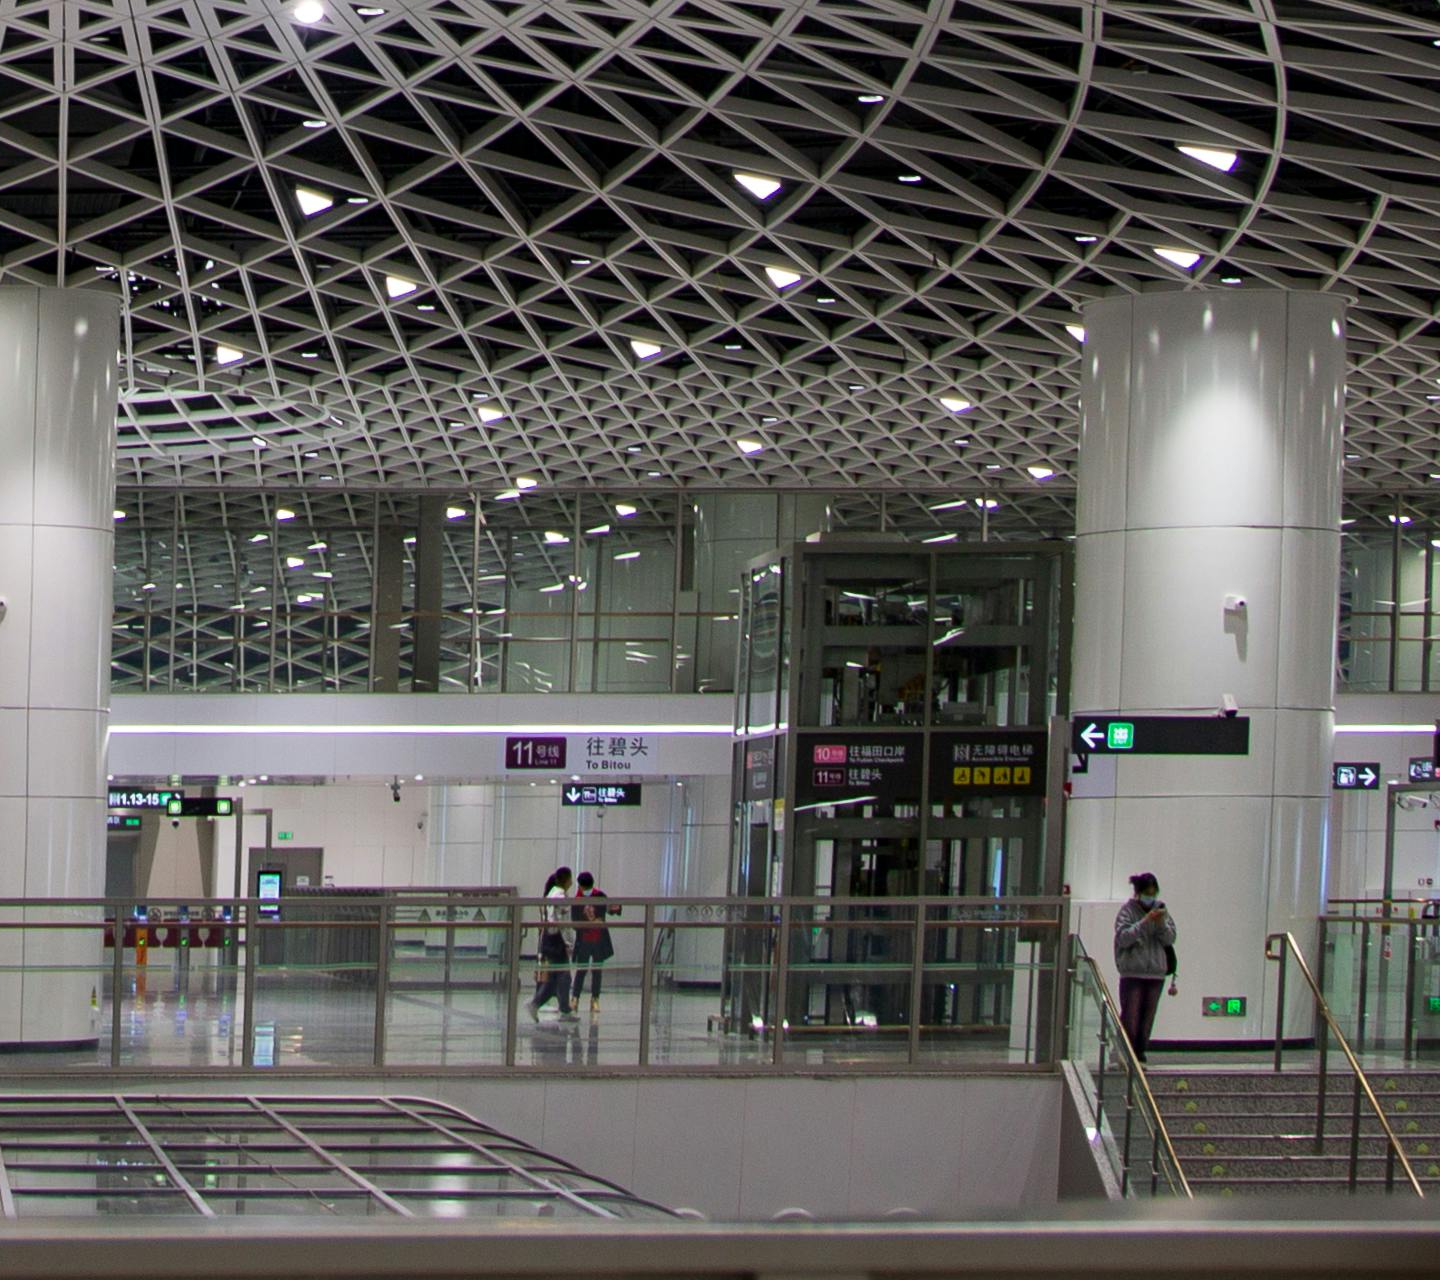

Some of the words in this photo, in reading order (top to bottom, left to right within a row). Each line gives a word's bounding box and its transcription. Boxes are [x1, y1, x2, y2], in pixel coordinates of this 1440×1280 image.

[586, 737, 648, 756] 往碧头
[849, 746, 905, 756] 往福田口岸
[586, 760, 598, 769] To
[602, 760, 631, 769] Bitou
[121, 793, 159, 806] 1.13-15
